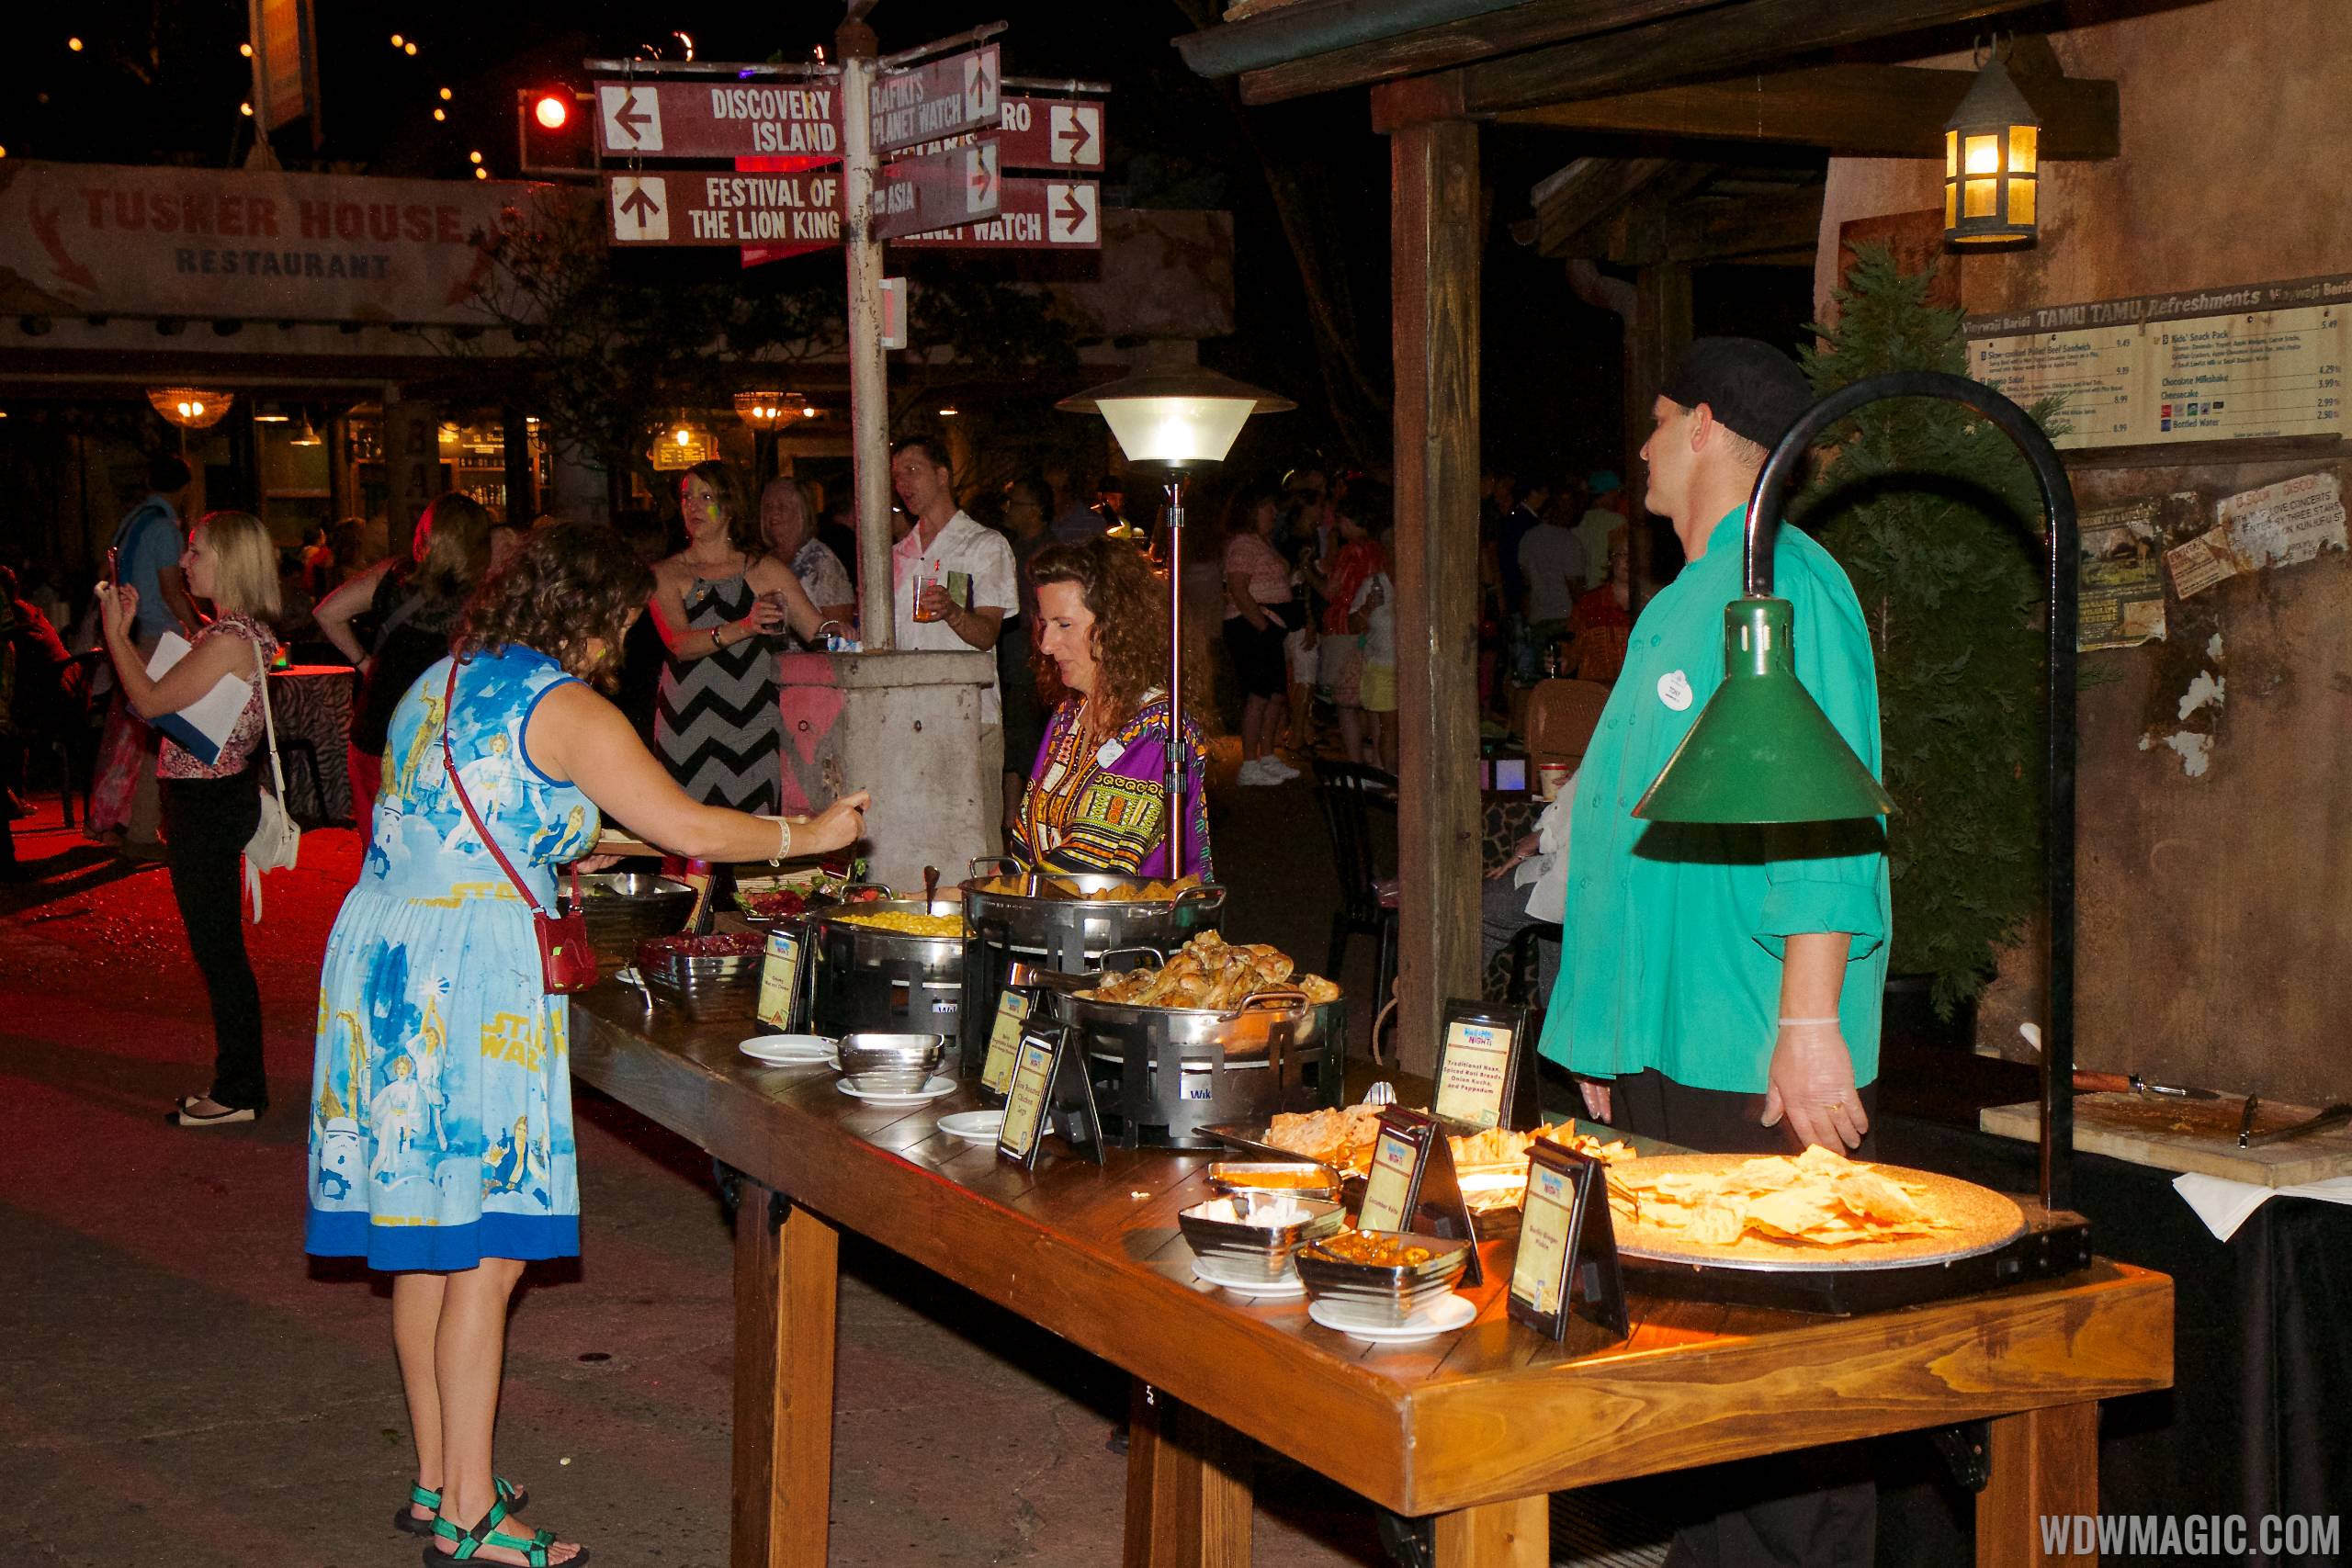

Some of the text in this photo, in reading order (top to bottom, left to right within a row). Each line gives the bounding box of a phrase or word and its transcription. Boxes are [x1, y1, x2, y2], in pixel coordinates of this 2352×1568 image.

[711, 88, 831, 119] DISCOVERY
[871, 72, 924, 114] RAFIKI'S
[873, 93, 962, 145] PLANET WATCH
[752, 121, 837, 152] ISLAND
[707, 177, 836, 208] FESTIVAL OF
[888, 182, 914, 214] ASIA
[80, 187, 466, 243] TUSKER HOUSE
[689, 209, 840, 240] THE LION KING
[974, 213, 1042, 241] WATCH
[175, 249, 391, 279] RESTAURANT
[2037, 305, 2086, 328] TAMU
[2090, 299, 2143, 323] TAMU
[2146, 289, 2261, 319] Refreshments
